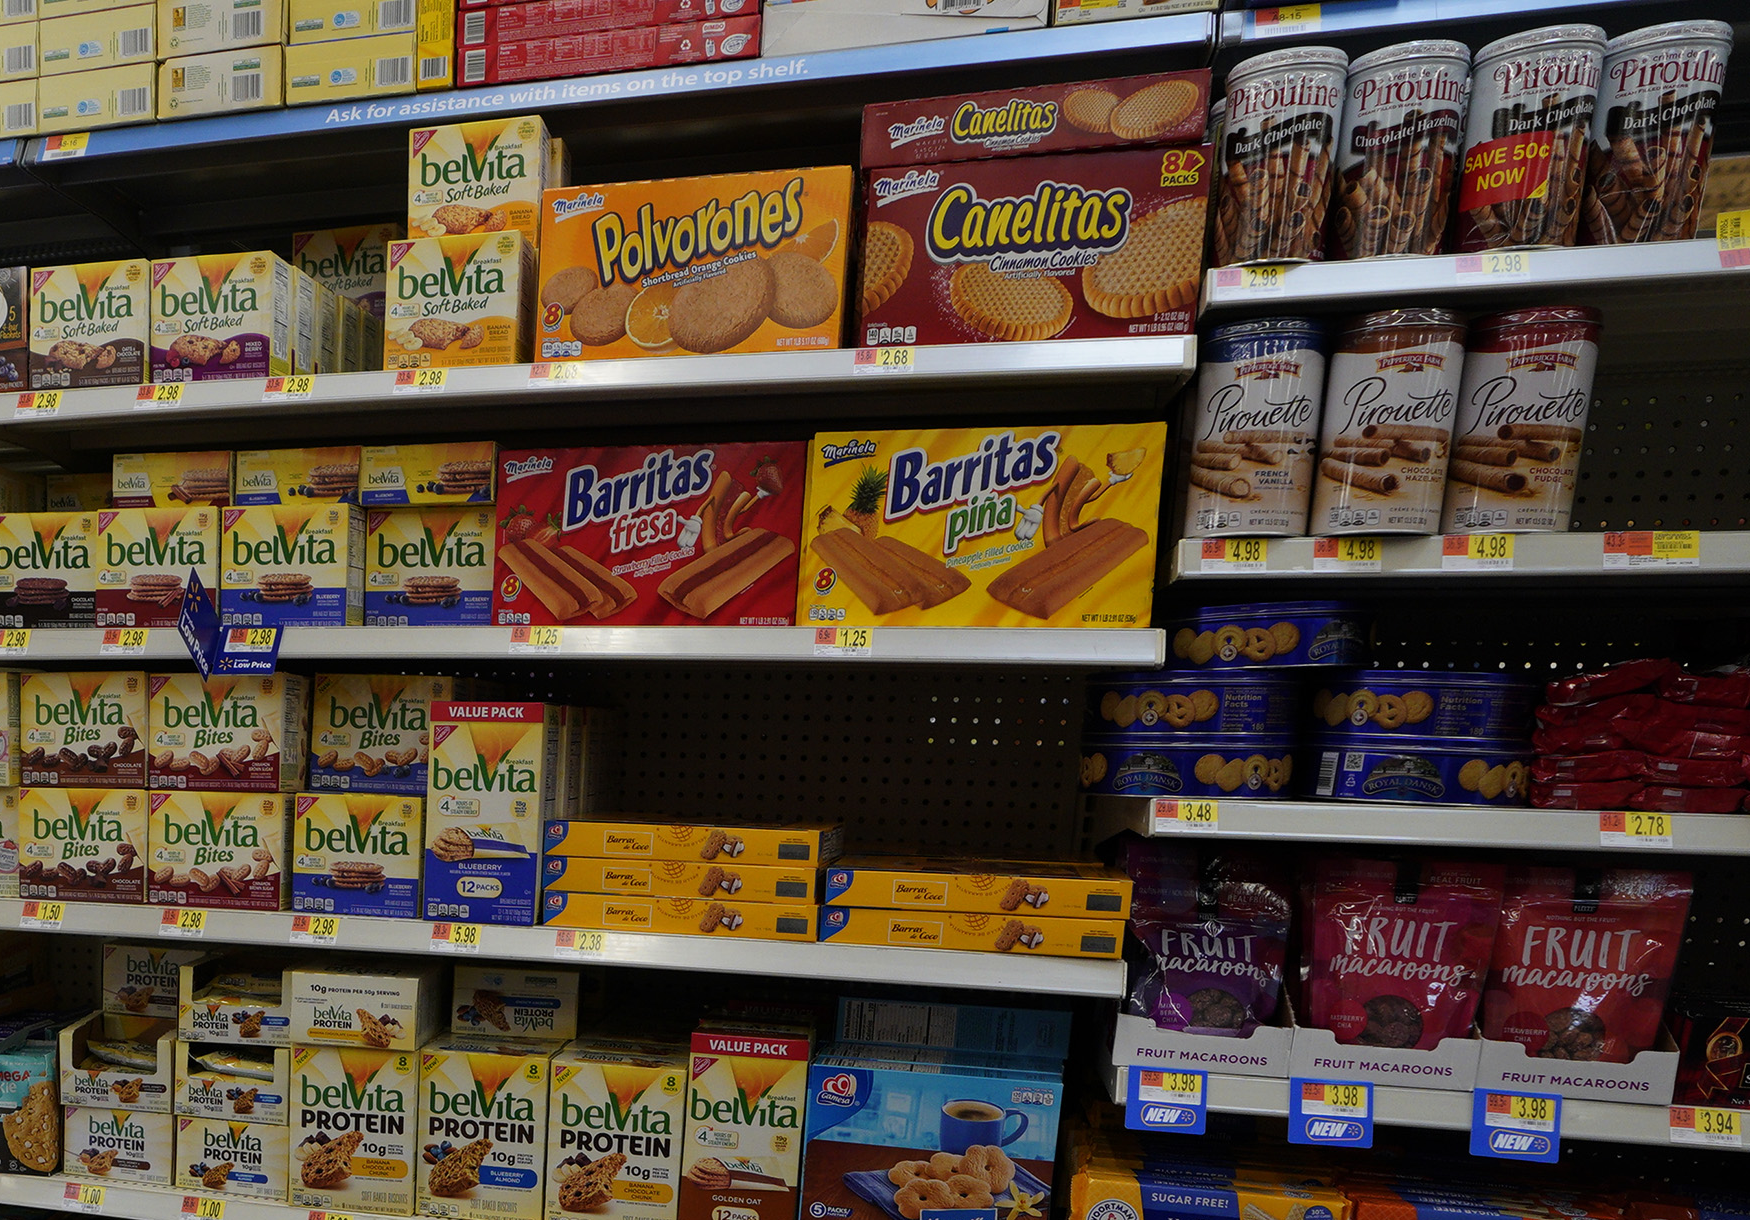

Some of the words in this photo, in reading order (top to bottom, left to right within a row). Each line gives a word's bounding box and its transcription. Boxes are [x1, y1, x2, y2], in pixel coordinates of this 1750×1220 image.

[510, 86, 555, 103] with
[562, 82, 617, 97] items
[626, 79, 654, 91] on
[660, 73, 692, 88] the
[704, 70, 742, 88] top
[754, 61, 807, 80] shelf.
[326, 108, 360, 123] Ask
[365, 104, 392, 120] for
[399, 91, 504, 112] assistance
[953, 100, 1055, 137] Canelitas
[1235, 137, 1260, 154] Dark
[1263, 119, 1323, 144] Chocolate
[1162, 152, 1182, 173] 8
[1465, 150, 1507, 173] SAVE
[1513, 142, 1549, 162] 50¢
[1163, 174, 1197, 184] PACKS
[1476, 168, 1525, 191] NOW
[593, 178, 804, 283] Polvorones
[928, 184, 1131, 255] Canelitas
[642, 270, 688, 288] Shortbread
[691, 261, 720, 273] Orange
[723, 252, 756, 265] Cookies
[990, 256, 1048, 273] Cinnamon
[1050, 251, 1097, 267] Cookies
[39, 286, 134, 319] belVita
[565, 451, 710, 526] Barritas
[887, 433, 1058, 518] Barritas
[1255, 470, 1289, 478] FRENCH
[1259, 477, 1294, 486] VANILLA
[611, 508, 674, 550] fresa
[946, 493, 1016, 550] piña
[232, 525, 337, 566] belVita
[34, 696, 124, 728] belVita
[63, 727, 101, 742] Bites
[458, 862, 502, 870] BLUEBERRY
[1522, 926, 1640, 968] FRUIT
[310, 985, 327, 994] 10g
[328, 986, 351, 994] PROTEIN
[1503, 965, 1652, 995] macaroons
[710, 1040, 748, 1051] VALUE
[752, 1042, 788, 1055] PACK
[1136, 1049, 1176, 1059] FRUIT
[1180, 1051, 1268, 1066] MACAROONS
[302, 1075, 405, 1113] belVita
[1502, 1072, 1544, 1083] FRUIT
[1549, 1075, 1649, 1091] MACAROONS
[302, 1111, 404, 1135] PROTEIN
[1146, 1107, 1181, 1123] NEW
[491, 1170, 524, 1178] BLUEBERRY
[745, 1197, 762, 1205] OAT
